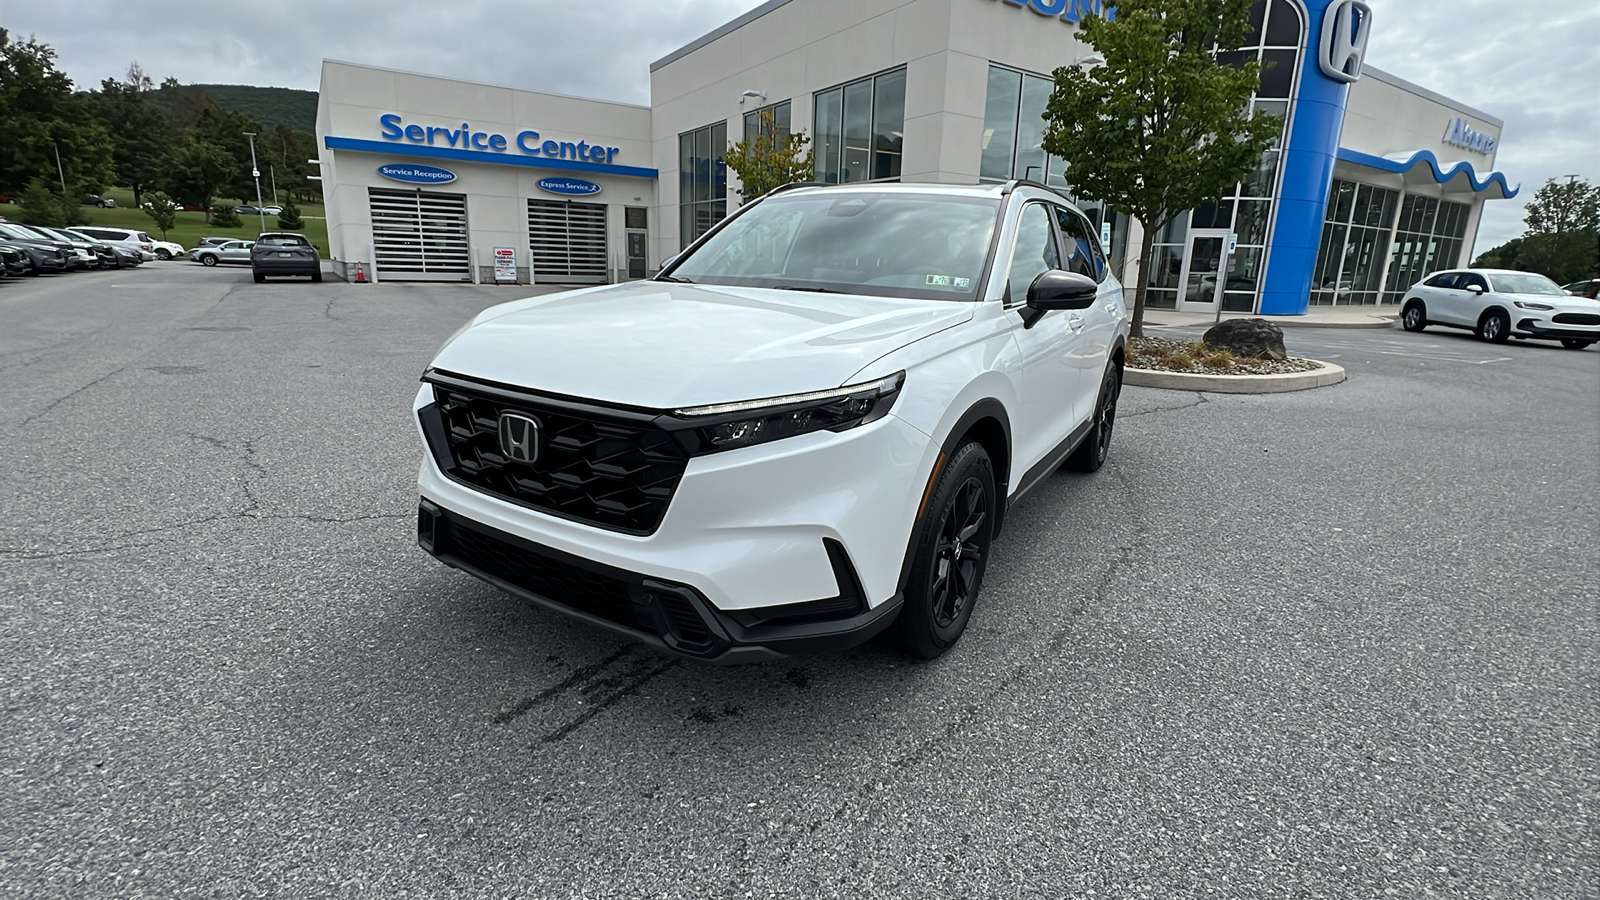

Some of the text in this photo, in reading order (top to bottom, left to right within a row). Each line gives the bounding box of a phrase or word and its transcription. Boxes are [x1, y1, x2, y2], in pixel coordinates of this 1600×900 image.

[380, 113, 620, 164] Service Center
[382, 166, 453, 180] Service Reception
[540, 180, 589, 191] Express Service
